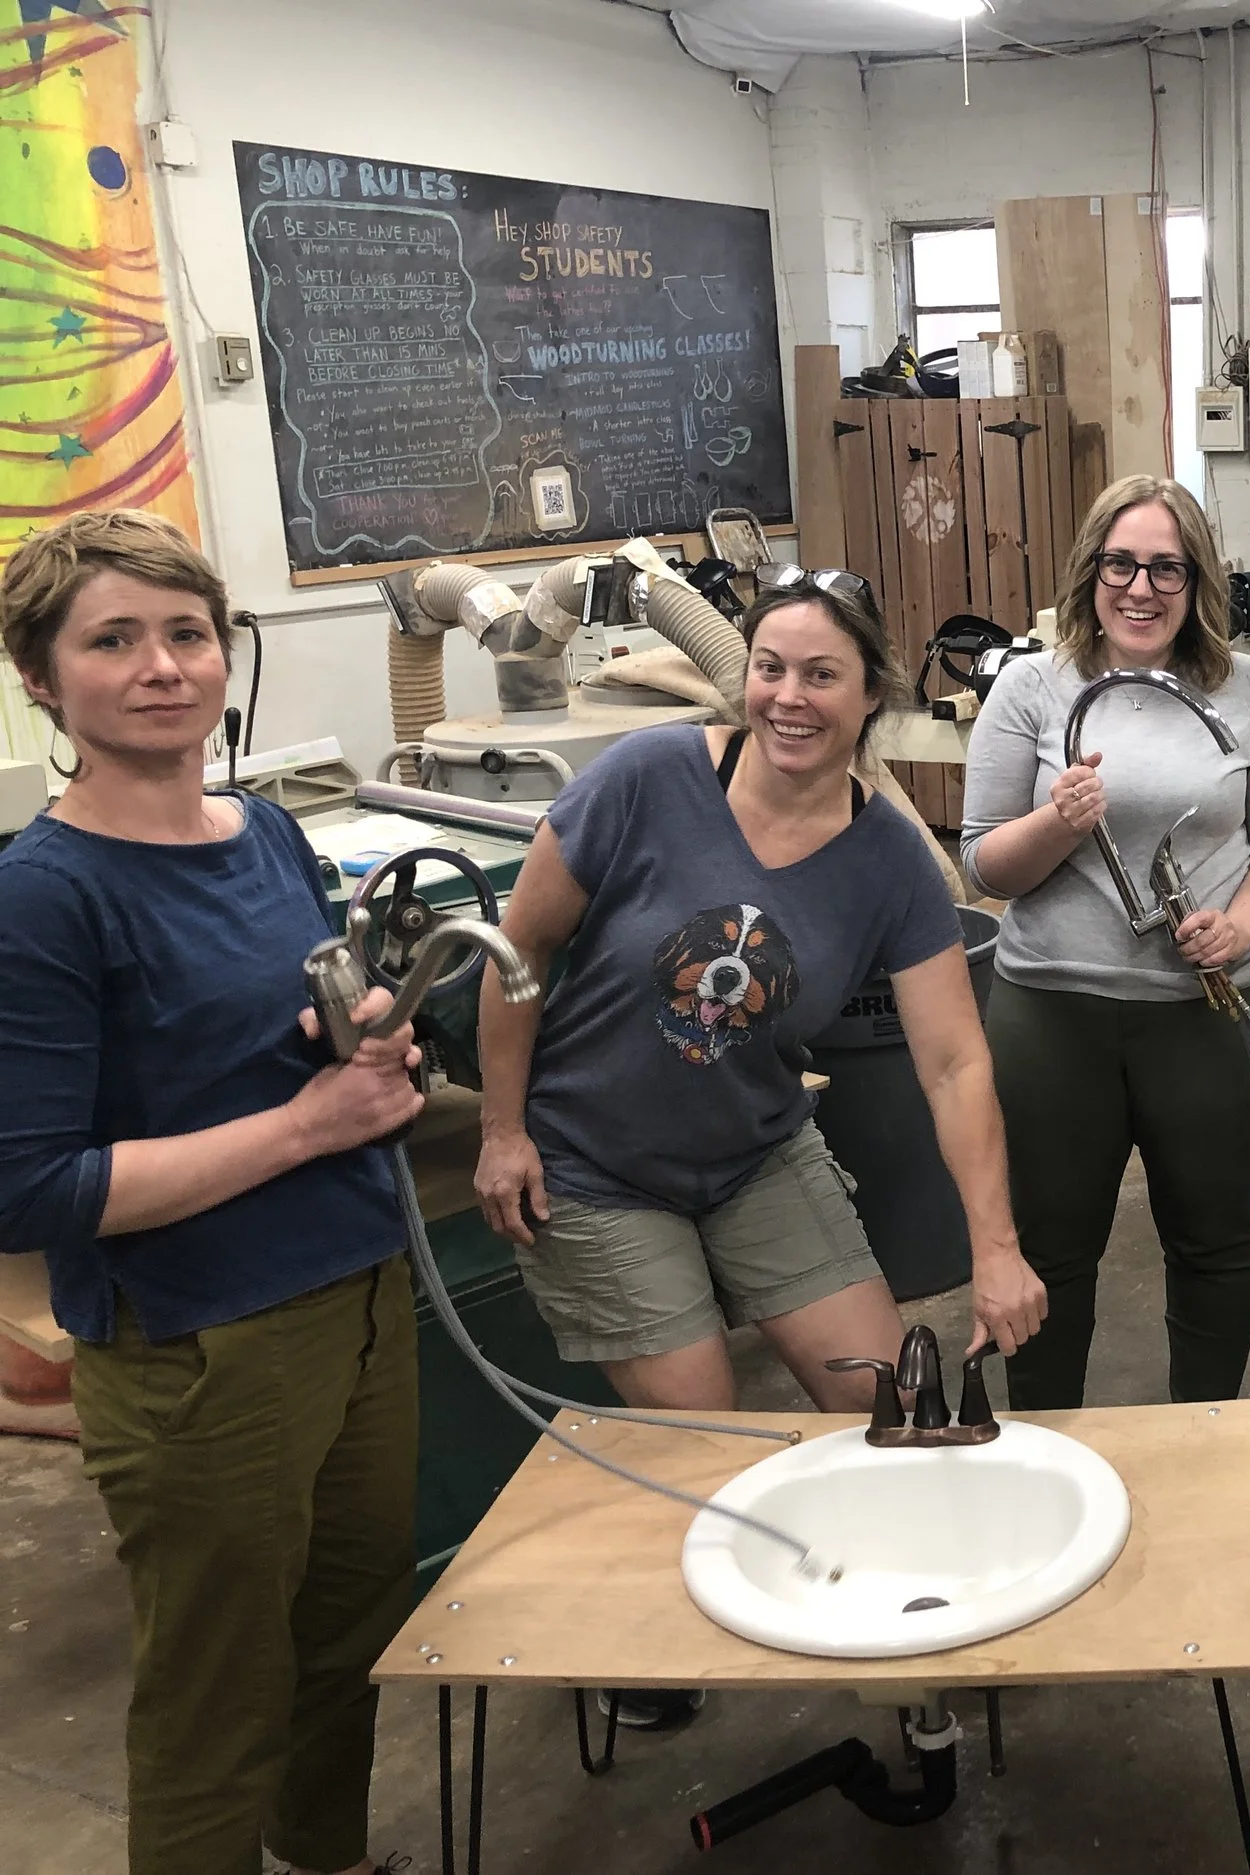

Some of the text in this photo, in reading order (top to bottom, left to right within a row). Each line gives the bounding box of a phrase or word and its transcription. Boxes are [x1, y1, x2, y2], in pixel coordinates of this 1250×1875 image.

[258, 152, 468, 200] SHOP RULES:
[283, 216, 307, 236] BE
[368, 224, 402, 240] HAVE
[534, 221, 571, 242] SHOP
[576, 224, 623, 247] SAFETY
[300, 239, 331, 255] When
[356, 242, 386, 256] doubt
[519, 246, 653, 282] STUDENTS
[296, 264, 342, 285] SAFETY
[350, 270, 396, 286] GLASSES
[404, 270, 436, 285] MUST
[444, 272, 460, 285] BE
[301, 288, 340, 301] WORN
[352, 289, 365, 300] AT
[373, 289, 394, 301] ALL
[308, 327, 357, 345] CLEAN
[364, 327, 380, 341] UP
[389, 323, 435, 340] BEGINS
[444, 324, 460, 337] NO
[514, 325, 543, 342] Then
[549, 325, 570, 339] take
[575, 326, 591, 337] one
[593, 321, 604, 334] of
[304, 344, 446, 363] LATER THAN 15 MINS
[527, 330, 750, 371] WOODTURNING CLASSES!
[308, 364, 358, 382] BEFORE
[368, 363, 421, 380] CLOSING
[565, 370, 600, 387] INTRO
[601, 371, 616, 382] TO
[296, 388, 327, 404] Please
[332, 388, 359, 400] start
[520, 429, 547, 449] SCAN
[551, 427, 562, 440] ME
[338, 493, 387, 514] THANK
[333, 513, 414, 531] COOPERATION
